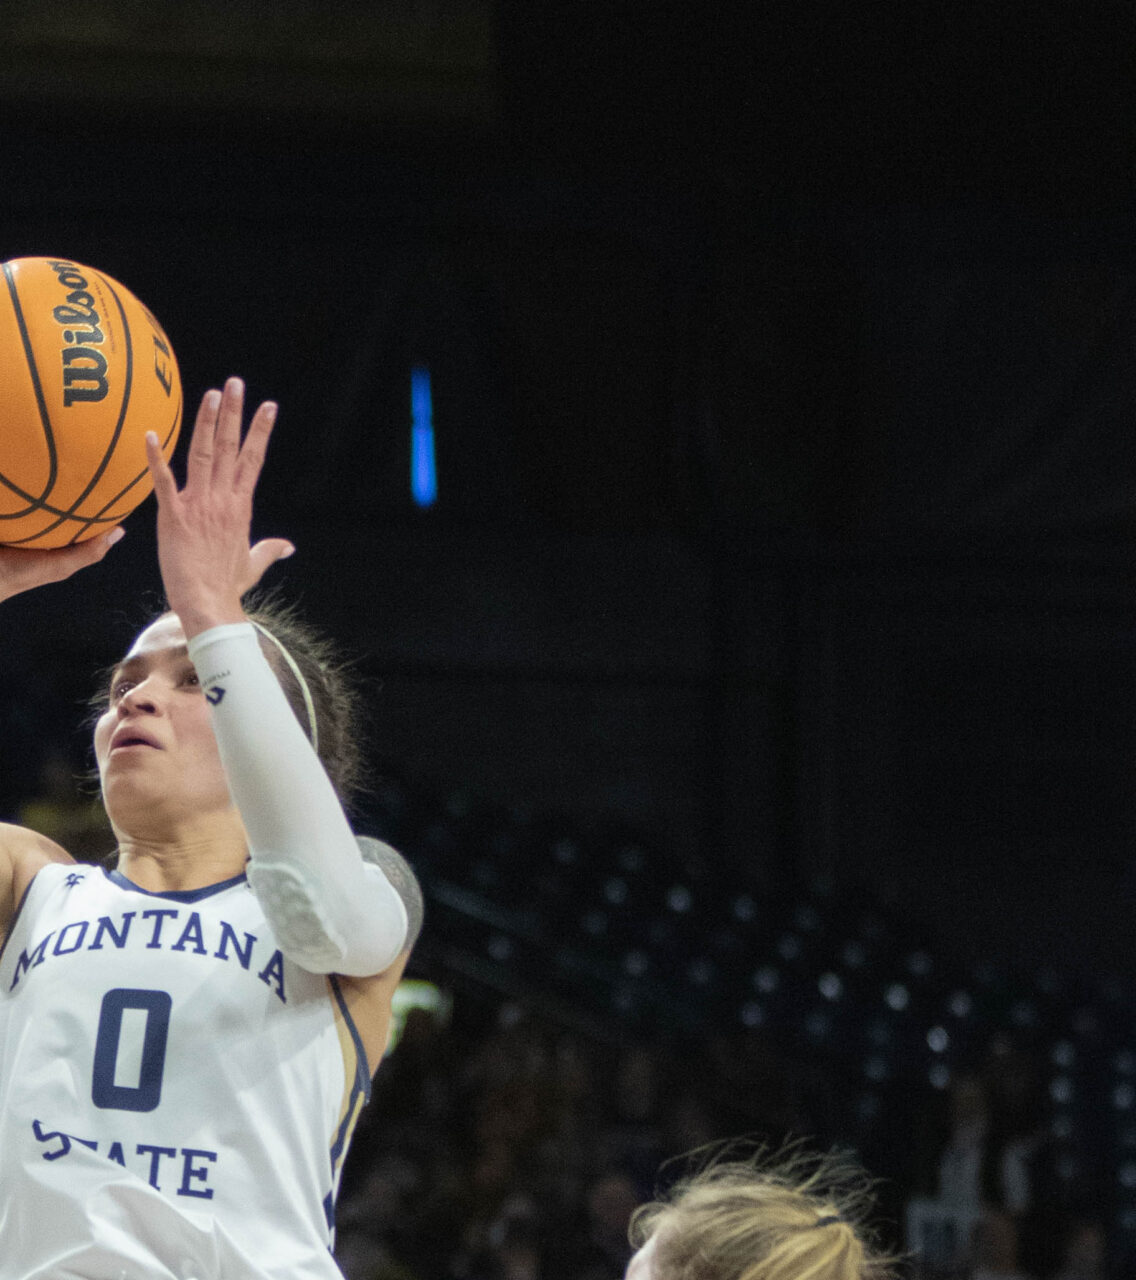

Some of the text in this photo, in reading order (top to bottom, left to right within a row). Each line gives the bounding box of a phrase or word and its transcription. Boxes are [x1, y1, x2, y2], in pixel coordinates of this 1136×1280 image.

[47, 261, 109, 407] Wilson
[10, 909, 287, 1003] MONTANA
[91, 988, 172, 1113] 0
[32, 1119, 217, 1200] STE
